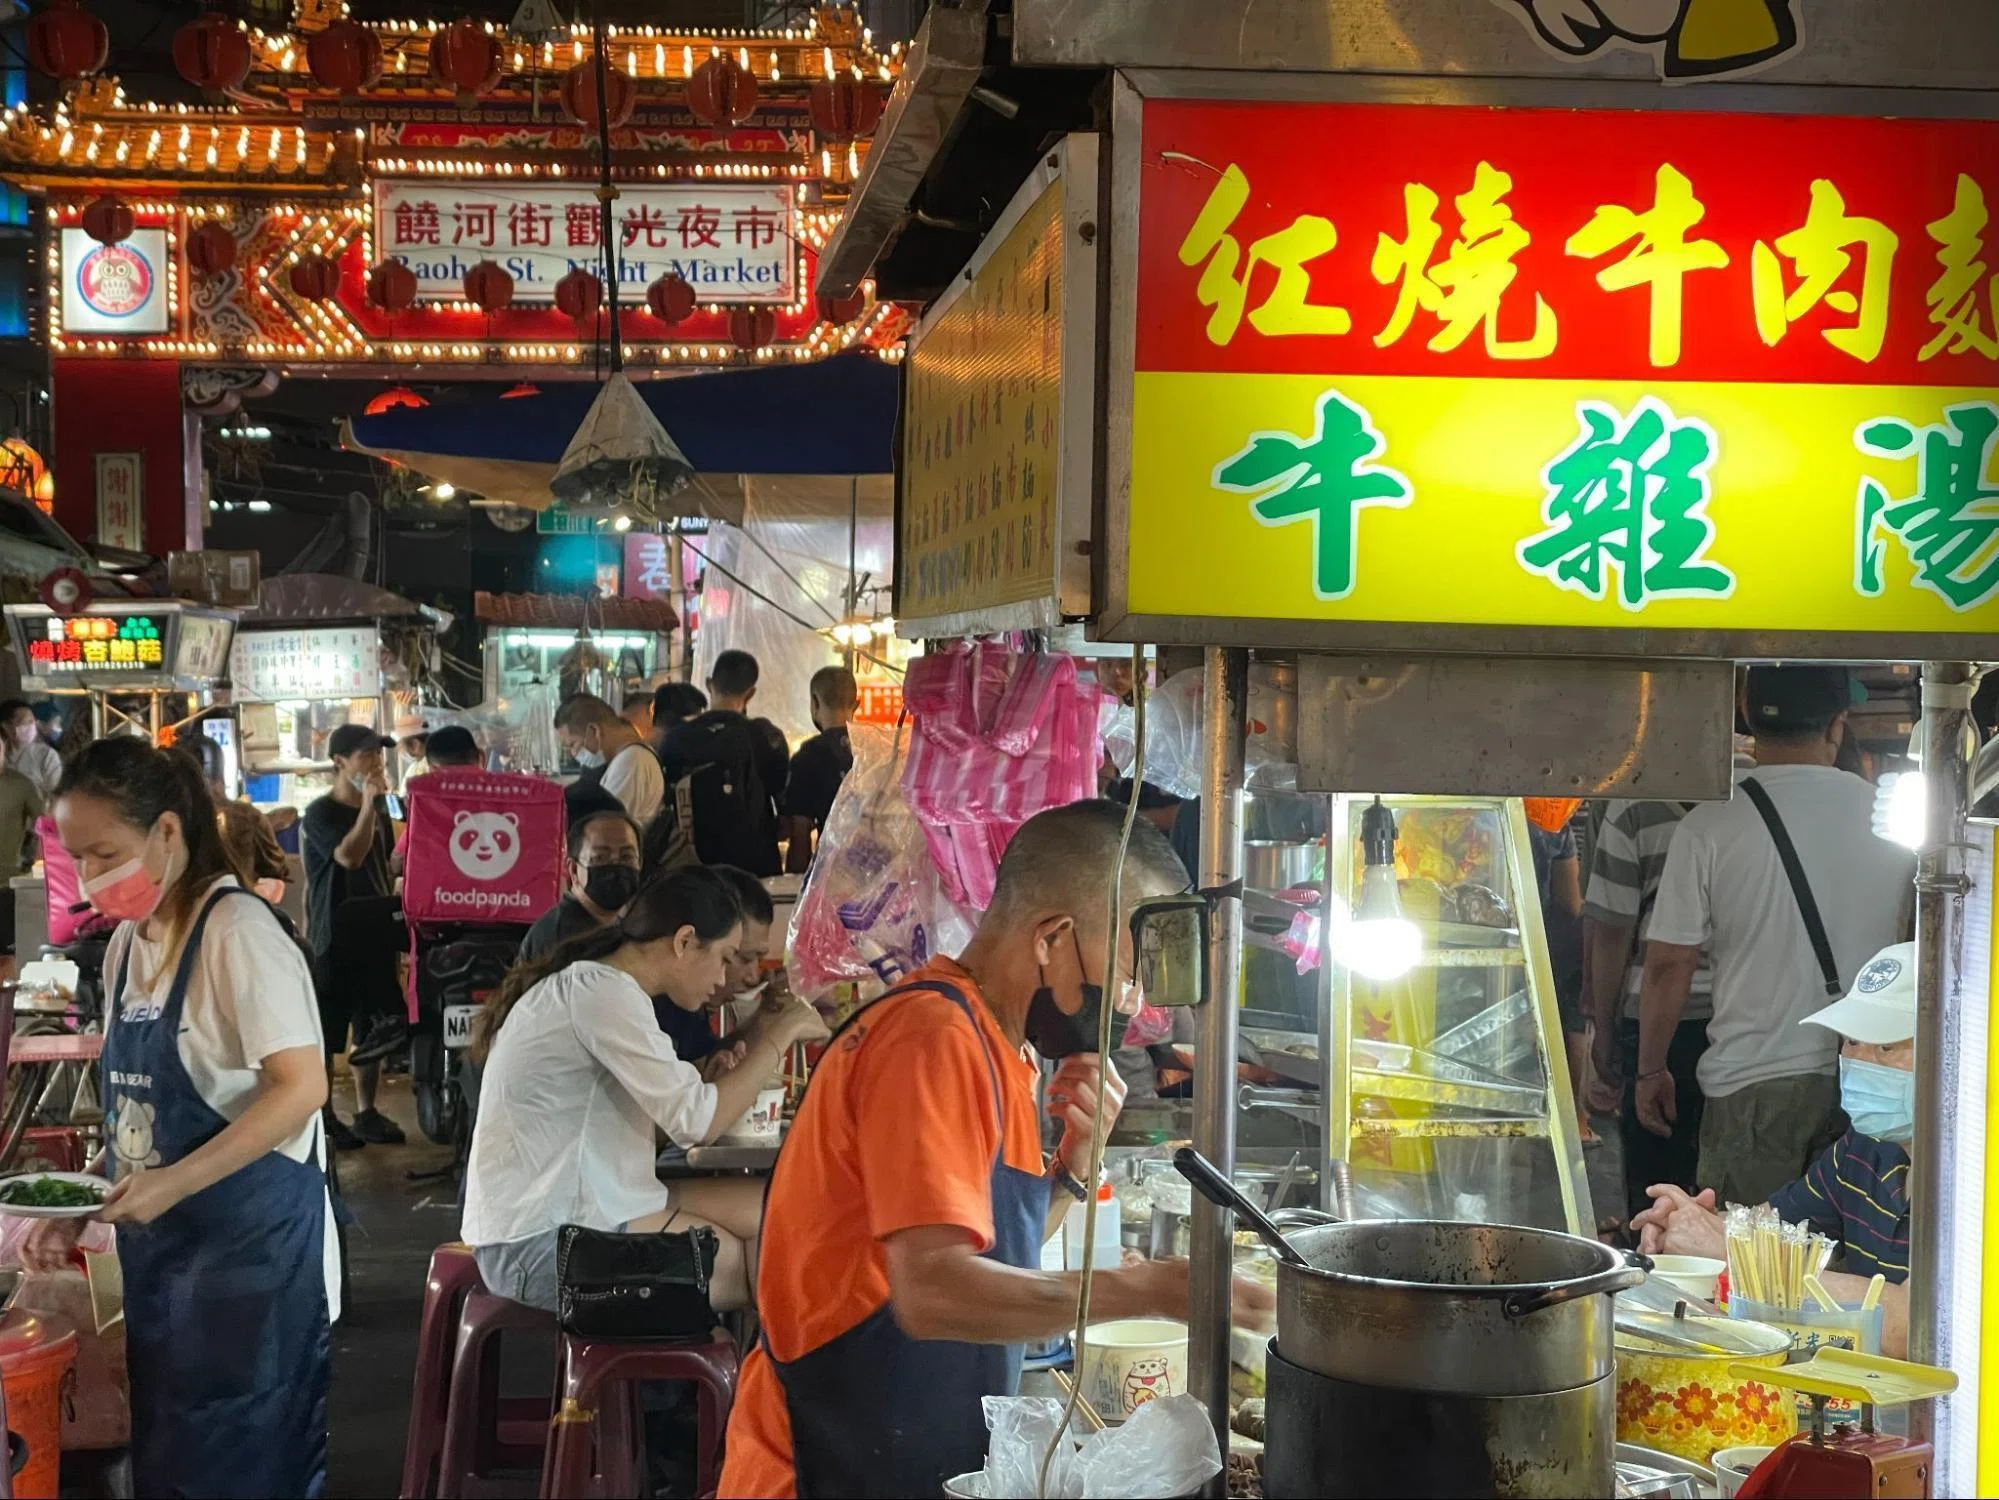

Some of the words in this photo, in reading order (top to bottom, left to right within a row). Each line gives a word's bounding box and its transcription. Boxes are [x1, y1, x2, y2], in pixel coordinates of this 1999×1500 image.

[393, 199, 779, 250] 饒河街觀光夜市
[506, 256, 544, 282] St.
[672, 257, 783, 284] Market
[434, 886, 530, 908] foodpanda
[447, 1016, 472, 1037] NA
